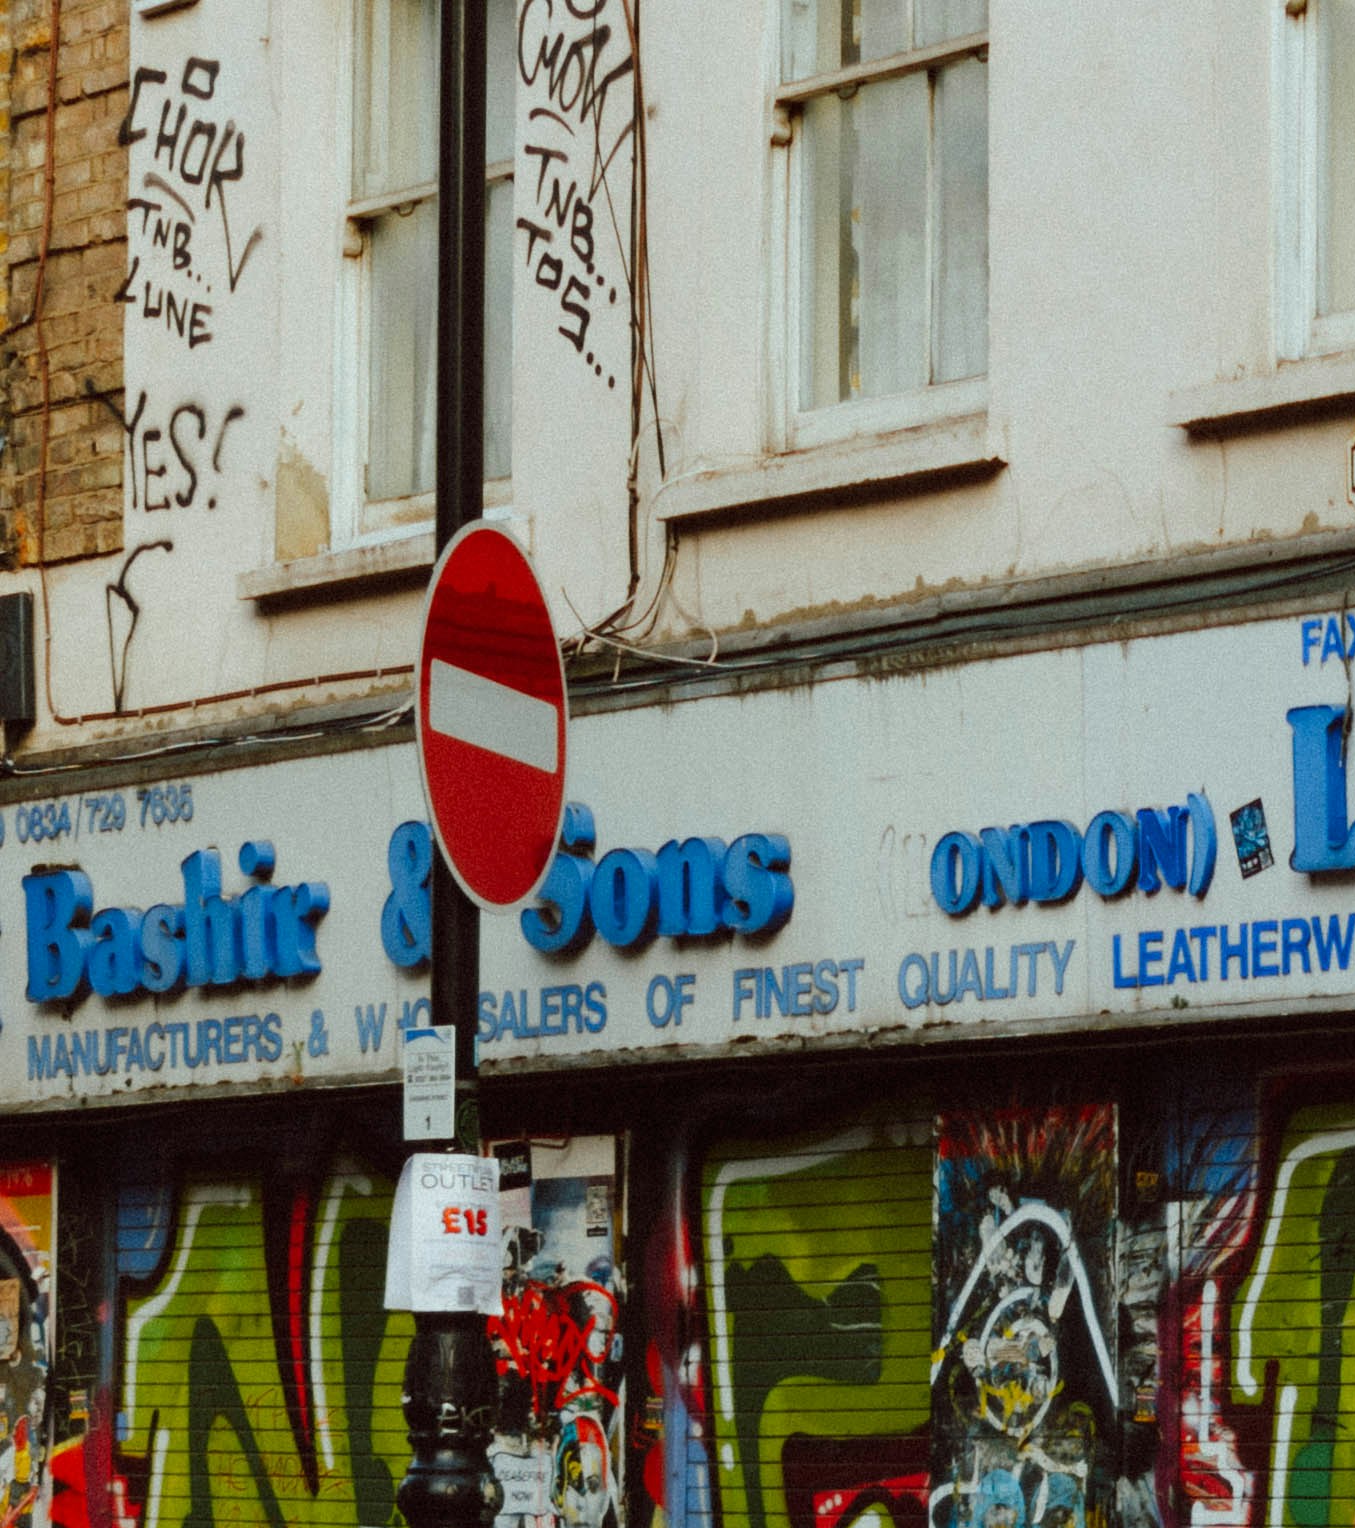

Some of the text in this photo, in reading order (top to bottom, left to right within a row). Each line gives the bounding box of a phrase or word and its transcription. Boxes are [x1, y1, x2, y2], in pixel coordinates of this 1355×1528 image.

[22, 840, 331, 1002] Bashir
[520, 802, 795, 954] Sons
[28, 1013, 284, 1080] MANUFACTURERS
[308, 1008, 330, 1056] &
[647, 974, 695, 1028] OF
[732, 958, 864, 1021] FINEST
[898, 940, 1075, 1008] QUALITY
[442, 1207, 487, 1236] £15
